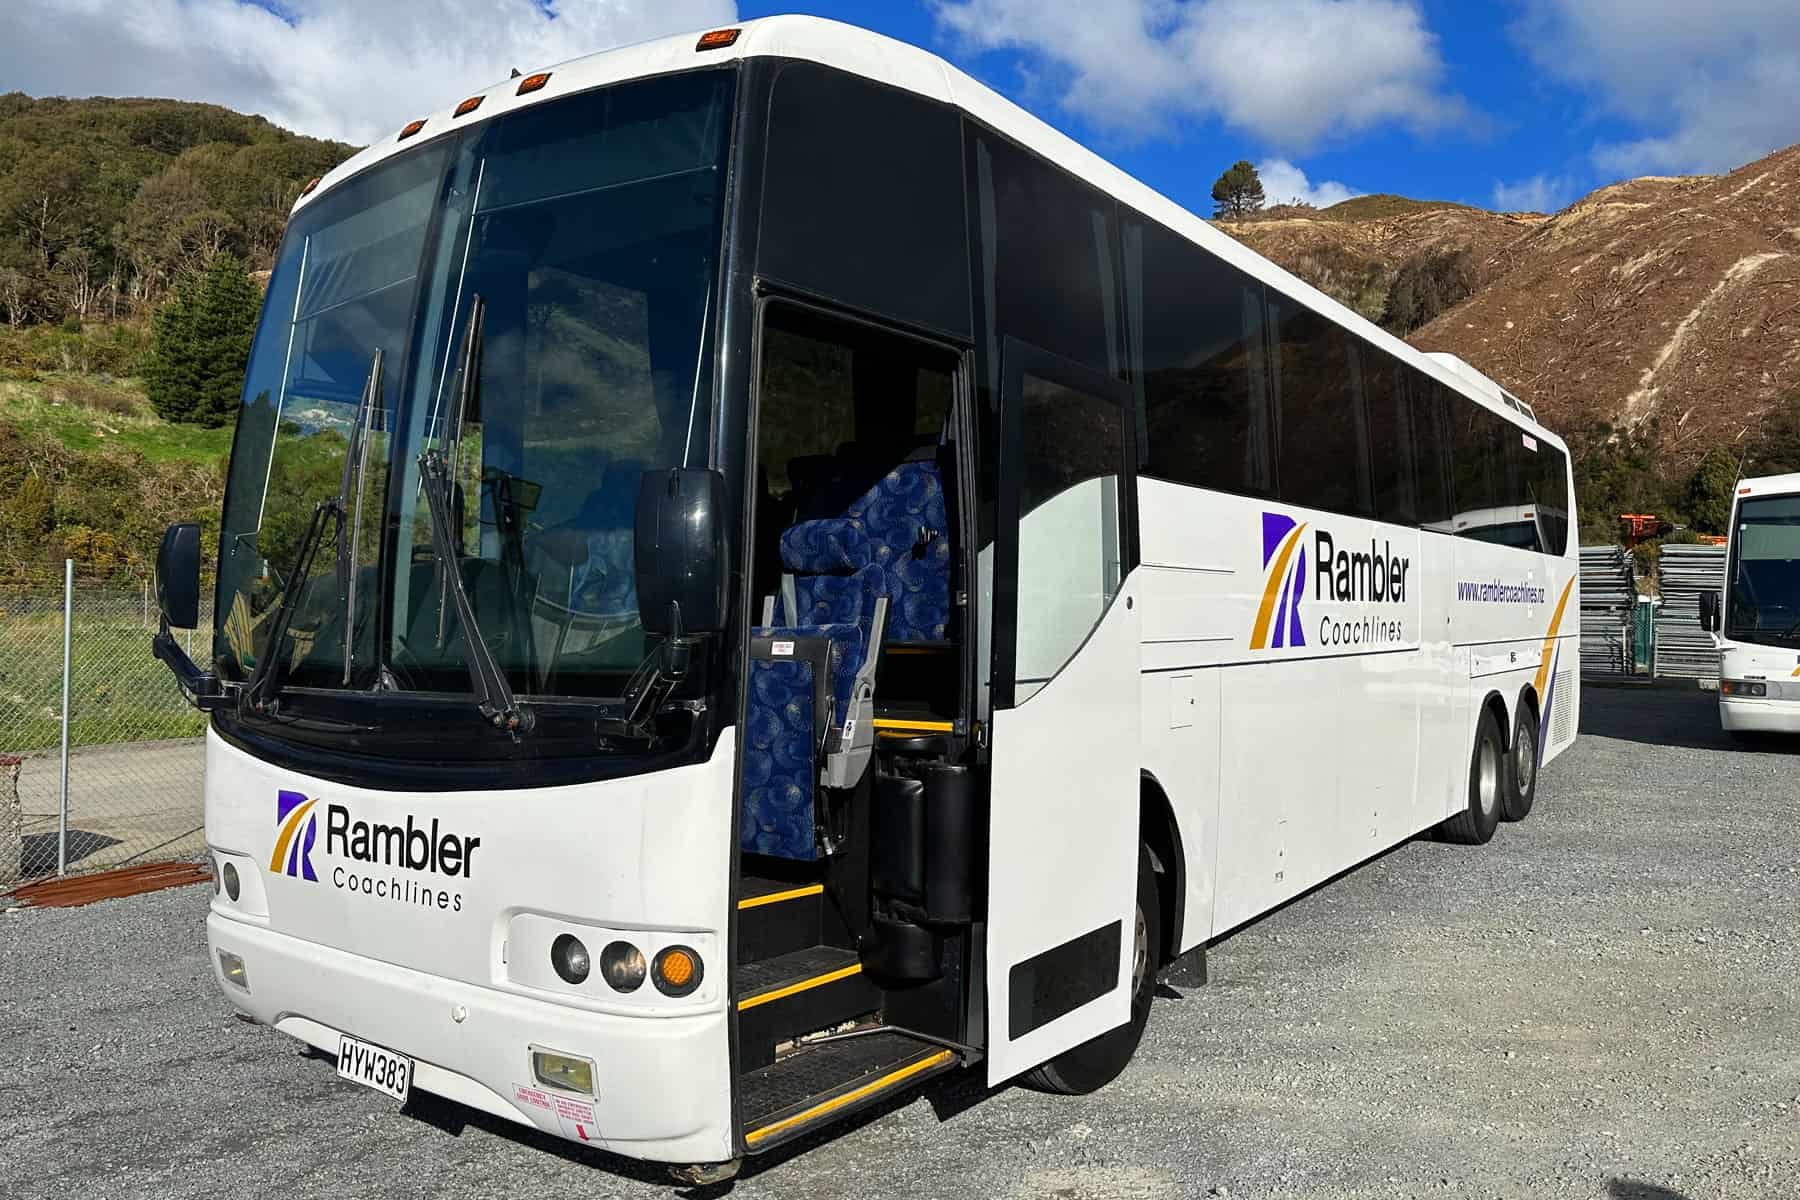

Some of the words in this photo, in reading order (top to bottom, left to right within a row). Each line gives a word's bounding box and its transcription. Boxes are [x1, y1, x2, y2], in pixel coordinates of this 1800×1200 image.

[1315, 530, 1409, 603] Rambler
[1319, 615, 1402, 646] Coachlines
[326, 804, 481, 878] Rambler
[333, 866, 463, 912] Coachlines
[341, 1042, 406, 1094] HYW383
